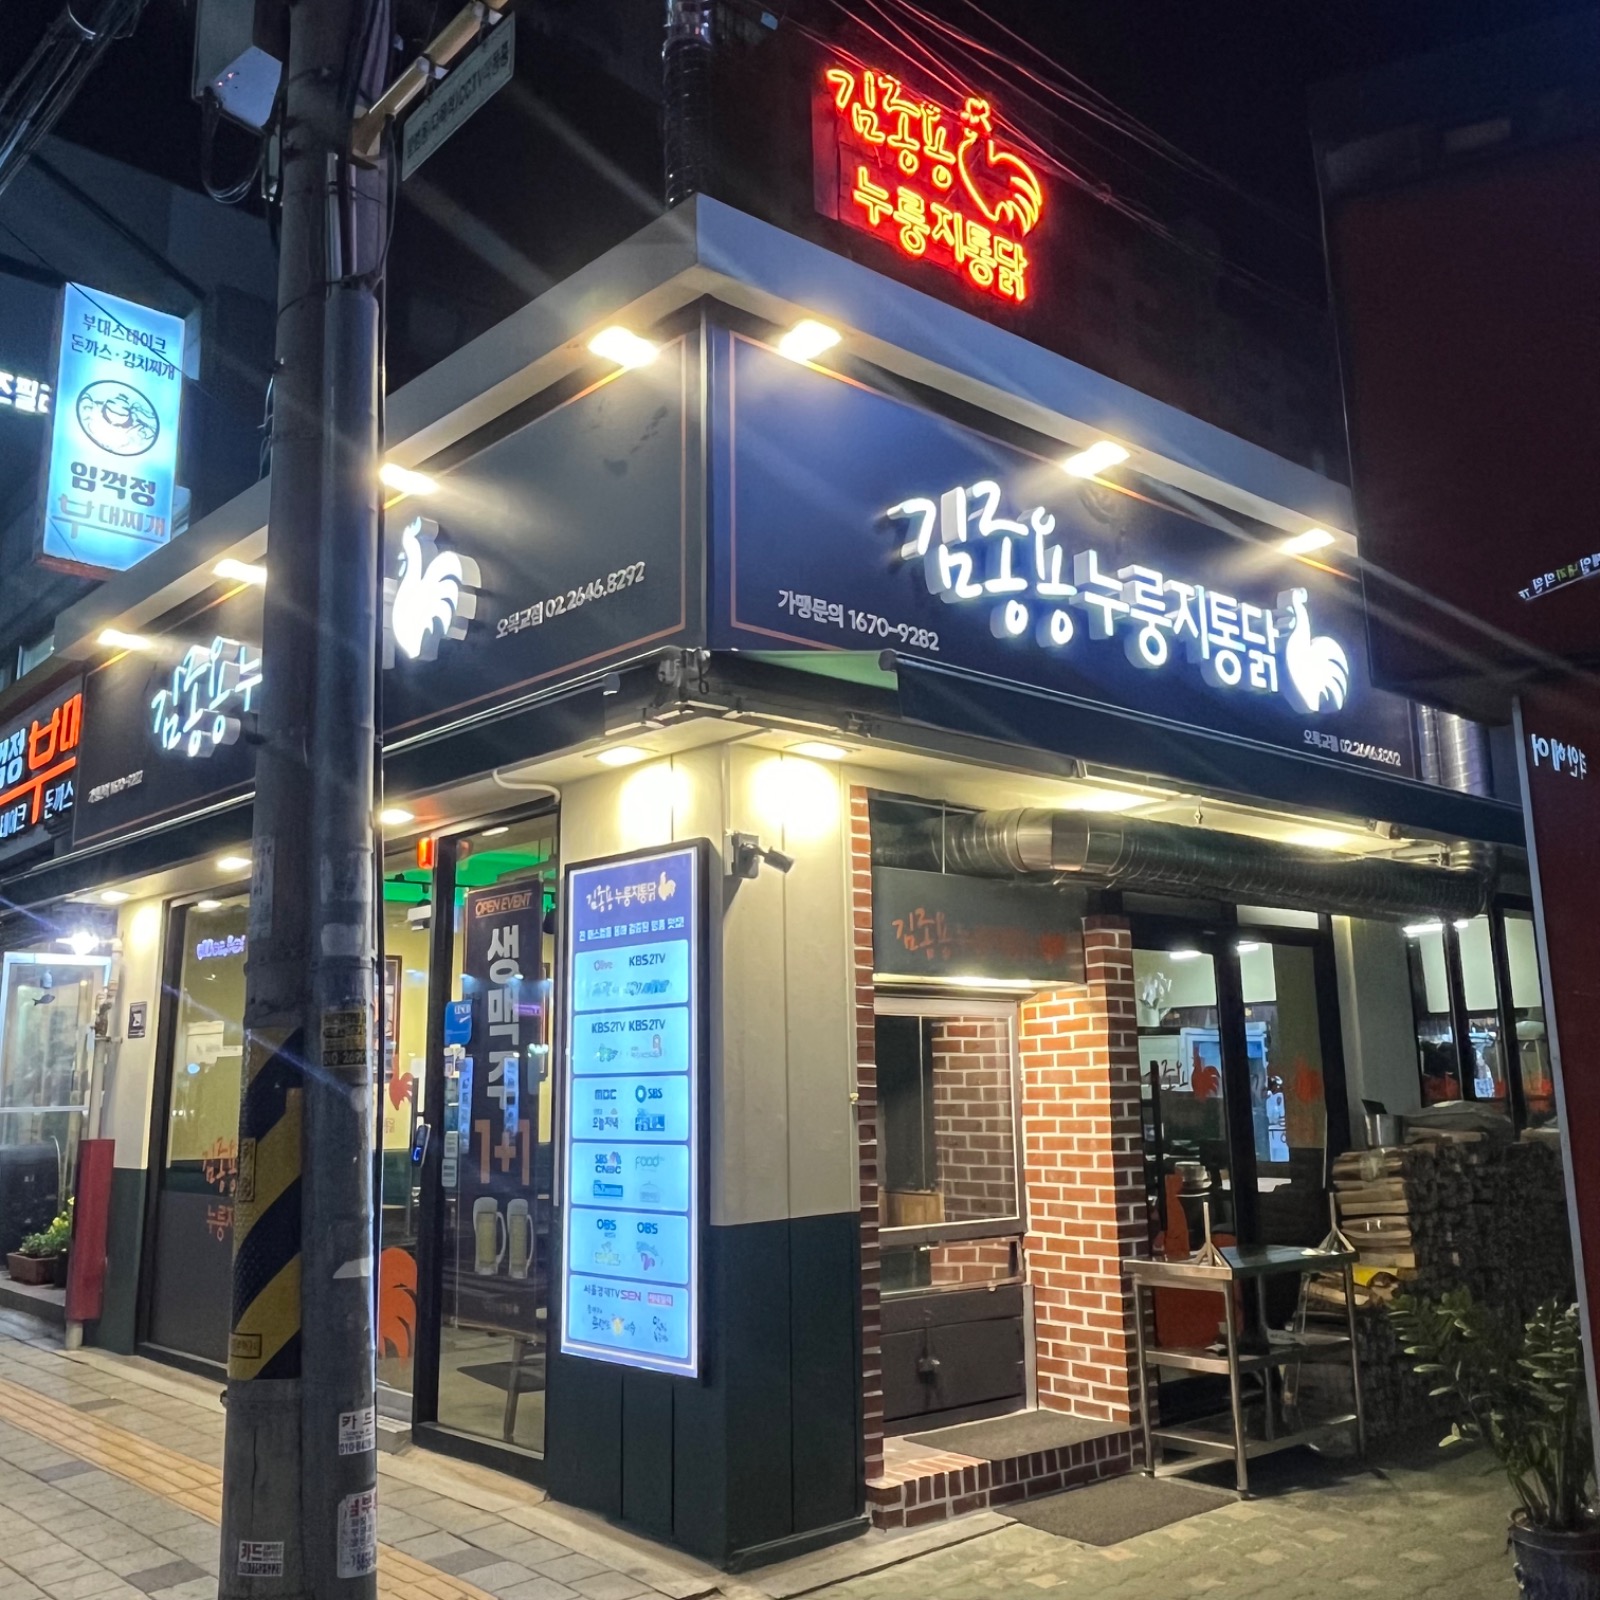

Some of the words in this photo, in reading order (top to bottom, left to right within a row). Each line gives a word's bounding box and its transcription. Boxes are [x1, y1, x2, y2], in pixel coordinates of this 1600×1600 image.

[826, 68, 956, 188] 김종용
[853, 166, 1027, 301] 누룽지통닭
[82, 313, 167, 355] 부대스테이크
[70, 461, 157, 507] 임꺽정
[58, 493, 166, 540] 부대찌개
[886, 480, 1078, 646] 김종용
[1072, 549, 1279, 693] 누룽지통닭
[495, 601, 544, 639] 오목교점
[778, 590, 845, 629] 가맹문의
[848, 608, 940, 652] 1670-9282
[44, 780, 74, 820] 돈까스
[475, 899, 500, 916] OPEN
[500, 893, 532, 911] EVENT
[487, 924, 520, 1111] 생맥주
[648, 1088, 663, 1100] SBS
[474, 1119, 530, 1186] 1+1
[596, 1218, 617, 1231] OBS
[636, 1222, 659, 1234] OBS
